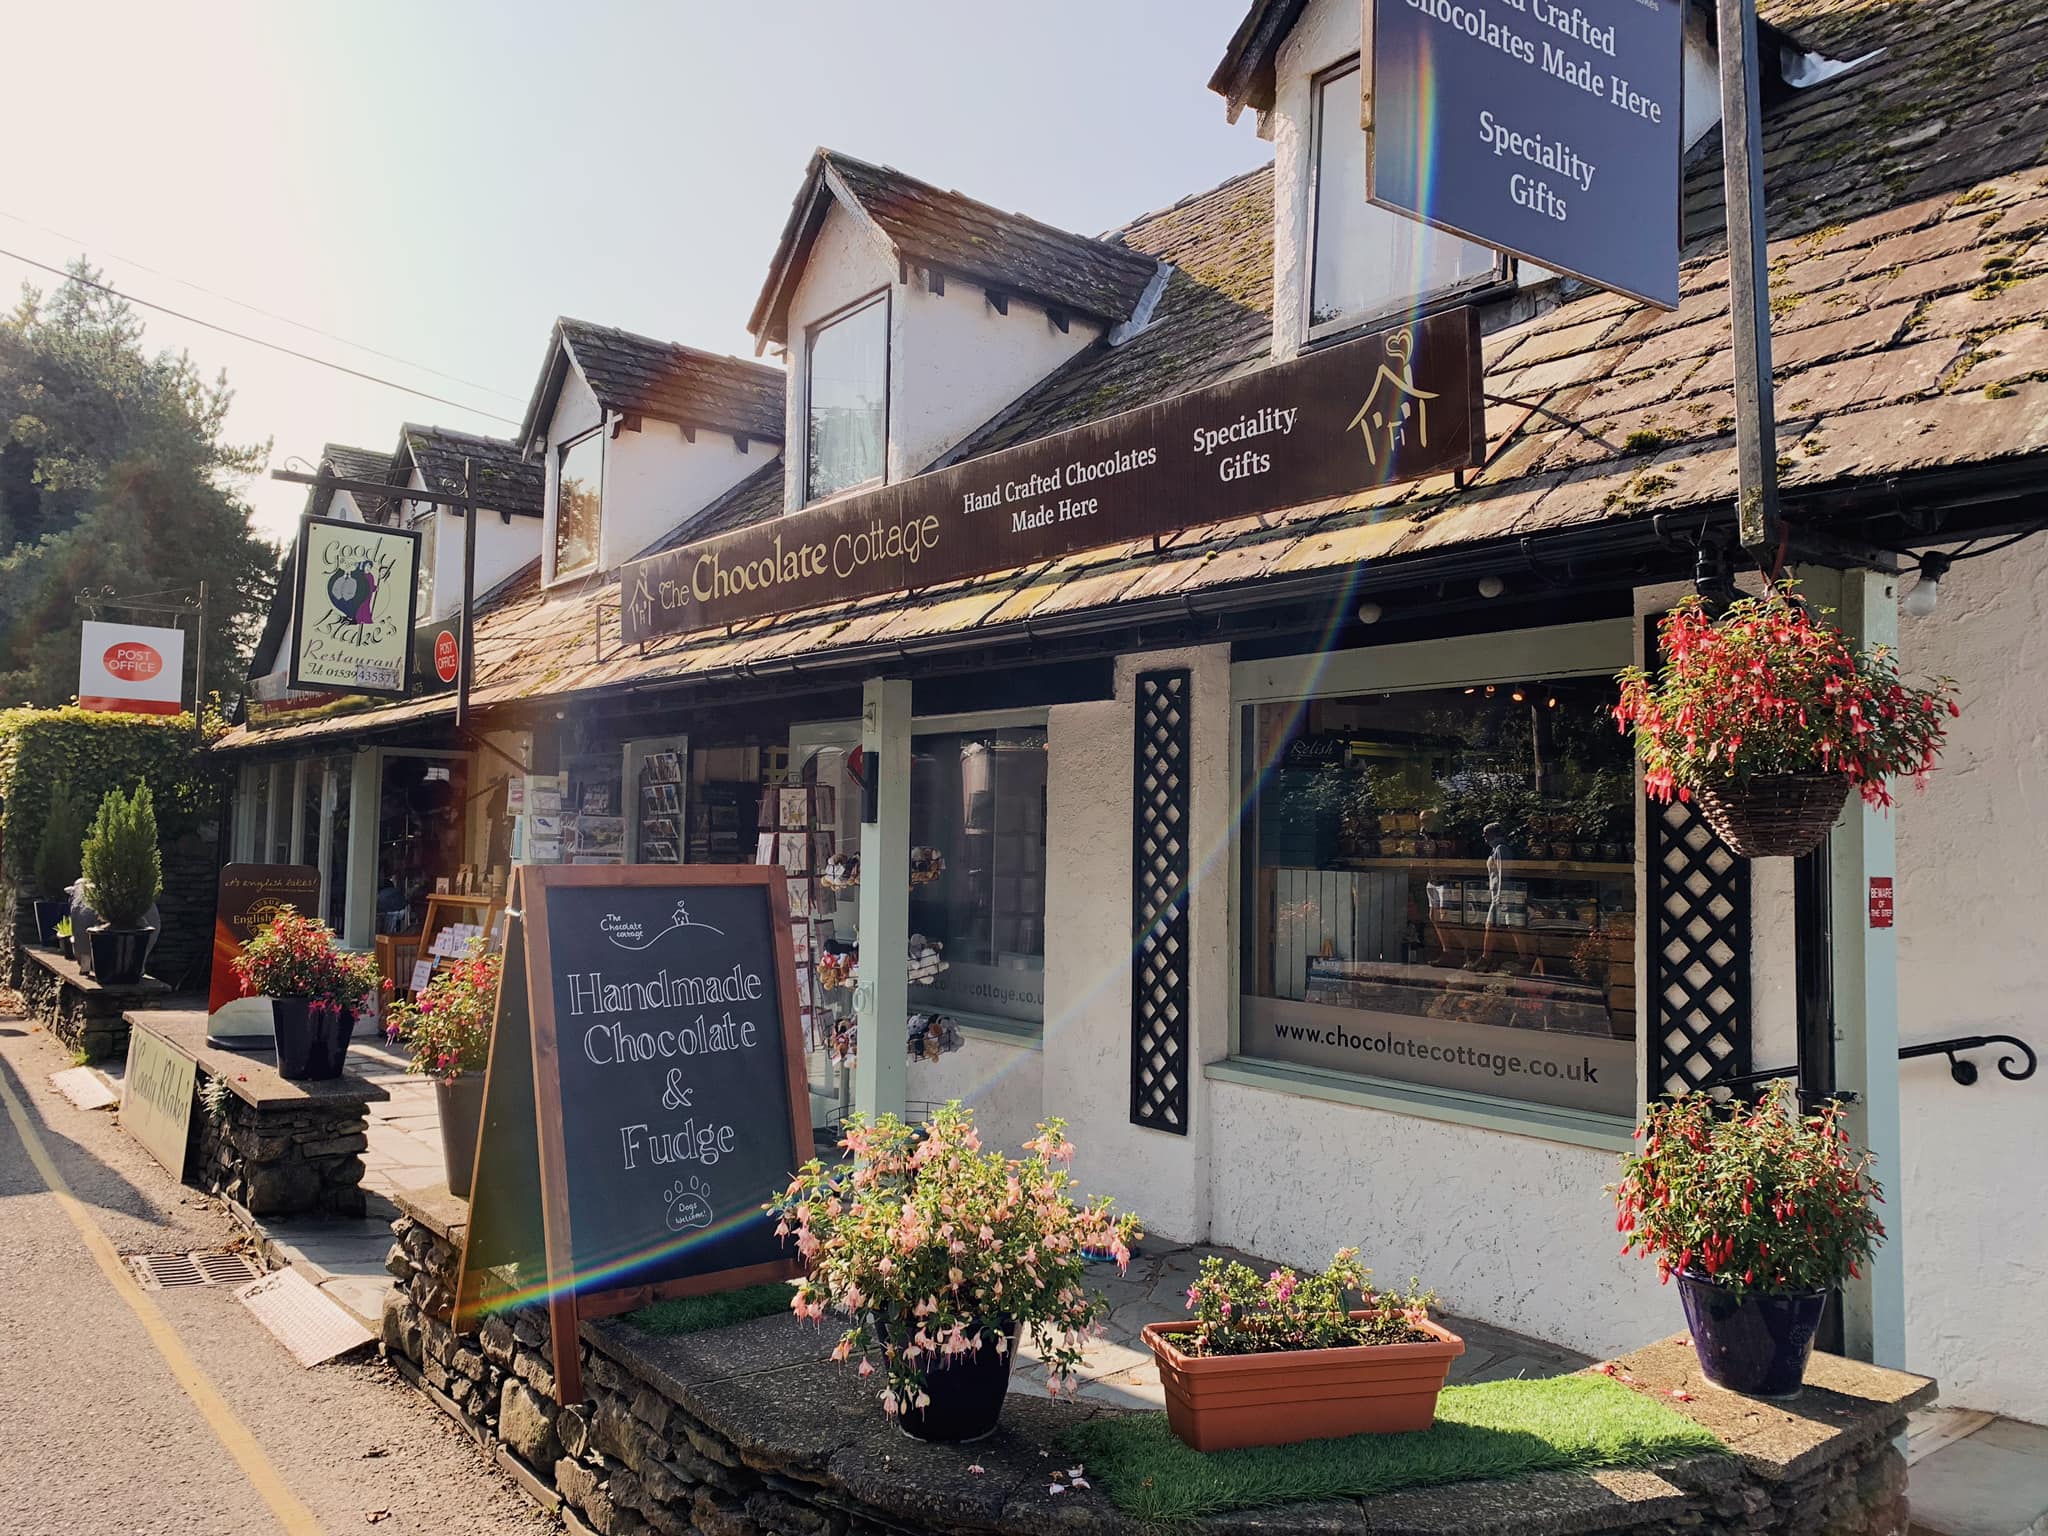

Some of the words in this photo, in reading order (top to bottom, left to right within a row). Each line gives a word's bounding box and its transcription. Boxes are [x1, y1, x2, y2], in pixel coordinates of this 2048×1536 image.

[1532, 0, 1616, 56] Crafted
[1406, 0, 1535, 64] ocolates
[1541, 41, 1604, 97] Made
[1611, 75, 1661, 123] Here
[1479, 110, 1595, 191] Speciality
[1510, 174, 1567, 221] Gifts
[1193, 407, 1298, 454] Speciality
[963, 486, 1001, 513] Hand
[1004, 467, 1061, 503] Crafted
[1065, 447, 1157, 487] Chocolates
[1219, 450, 1270, 482] Gifts
[1011, 507, 1054, 533] Made
[1058, 497, 1098, 522] Here
[323, 537, 396, 582] Goody
[658, 580, 690, 610] The
[691, 534, 828, 602] Chocolate
[833, 514, 940, 579] Cottage
[108, 660, 156, 673] OFFICE
[117, 649, 152, 661] POST
[303, 639, 402, 669] Restaurant
[437, 655, 456, 669] OFFICE
[439, 641, 453, 655] POST
[600, 919, 642, 931] Chocolate
[567, 963, 762, 1016] Handmade
[584, 1011, 758, 1065] Chocolate
[1274, 1022, 1599, 1084] www.chocolatecottage.co.uk
[662, 1067, 694, 1110] &
[619, 1117, 735, 1170] Fudge
